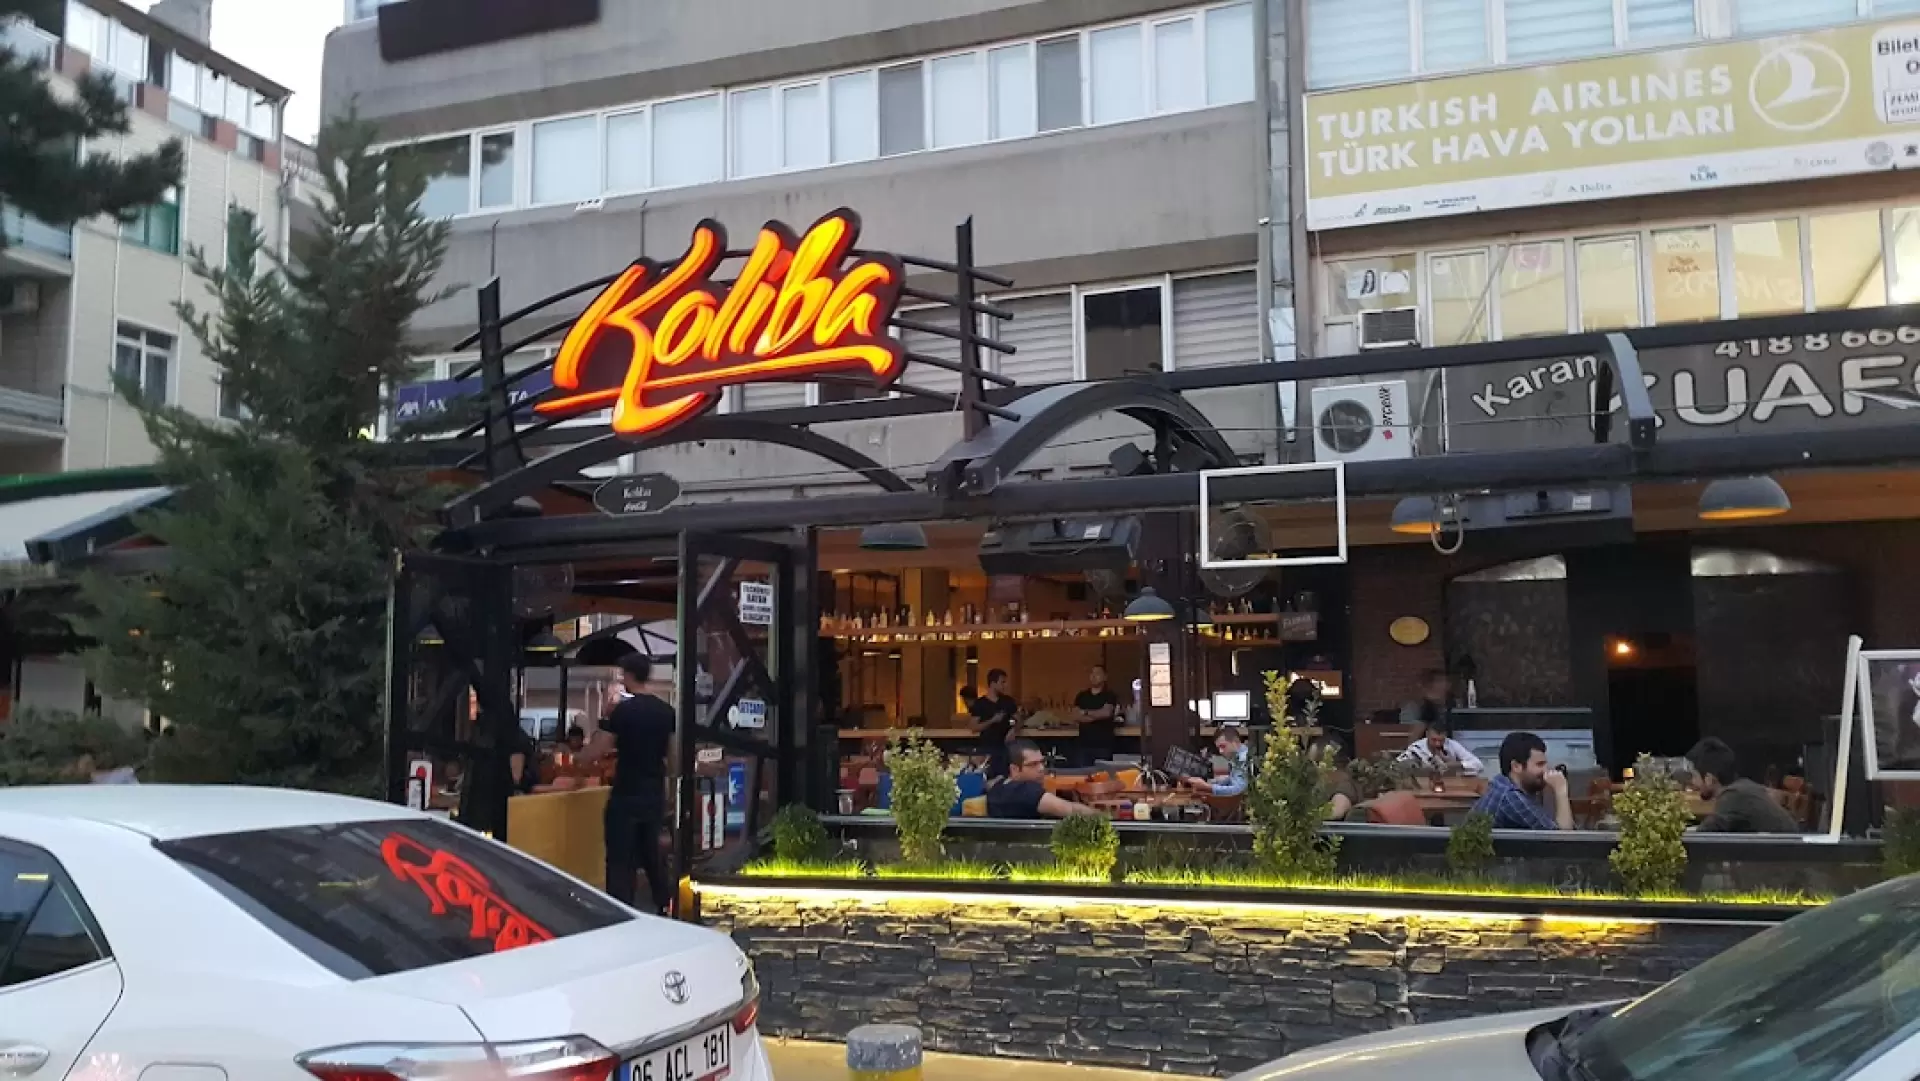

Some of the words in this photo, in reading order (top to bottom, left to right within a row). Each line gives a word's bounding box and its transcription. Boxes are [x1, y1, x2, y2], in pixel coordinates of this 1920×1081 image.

[1317, 92, 1496, 144] TURKISH
[1531, 64, 1732, 116] AIRLINES
[1318, 141, 1418, 178] TÜRK
[1432, 124, 1549, 166] HAVA
[1562, 102, 1735, 149] YOLLARI
[536, 214, 893, 434] Koliba
[1471, 355, 1598, 417] Karan
[666, 1044, 694, 1081] ACL
[703, 1030, 725, 1069] 181
